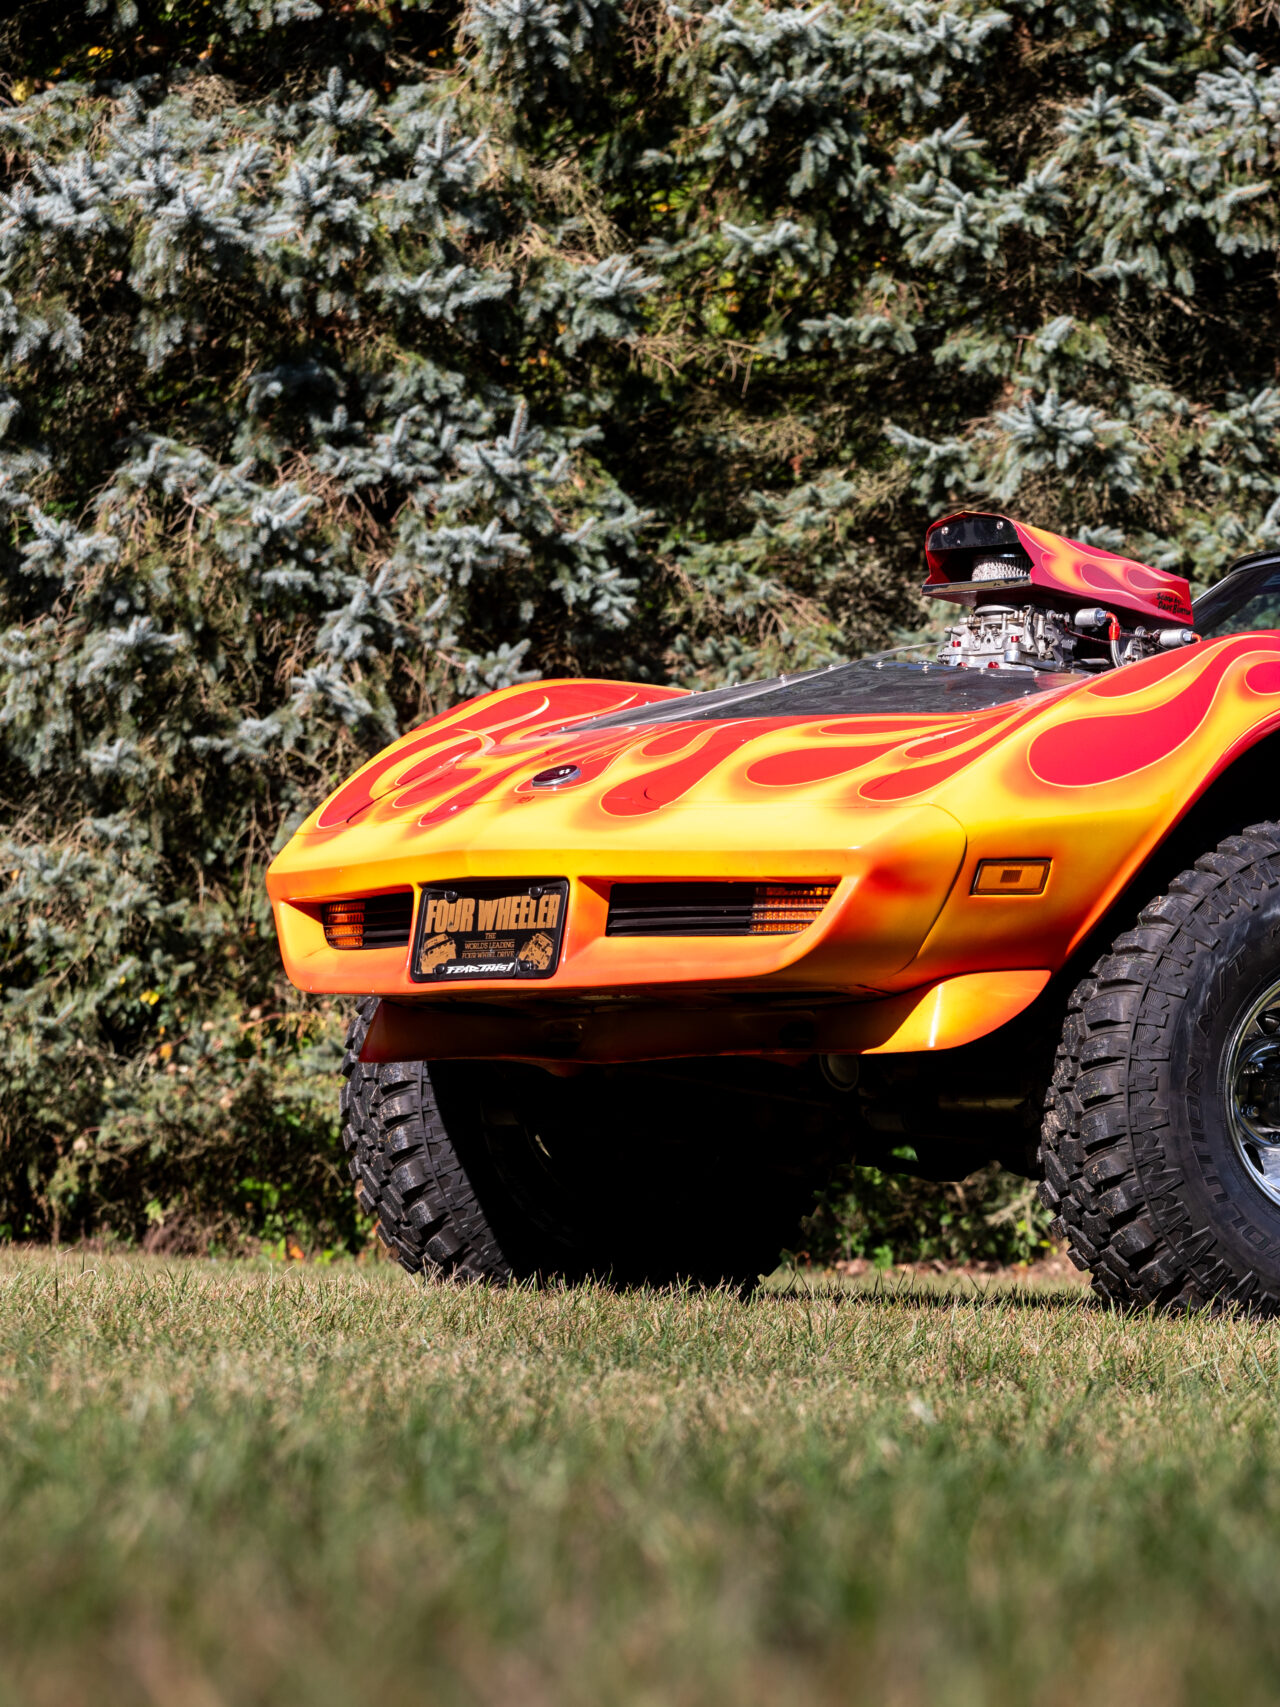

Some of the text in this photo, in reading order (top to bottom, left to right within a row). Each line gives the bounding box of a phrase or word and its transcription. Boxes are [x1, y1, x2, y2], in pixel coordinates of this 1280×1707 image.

[425, 894, 561, 933] FOUR WHEELER
[485, 932, 497, 940] THE
[489, 941, 515, 949] LEADING
[446, 965, 480, 974] FEAR
